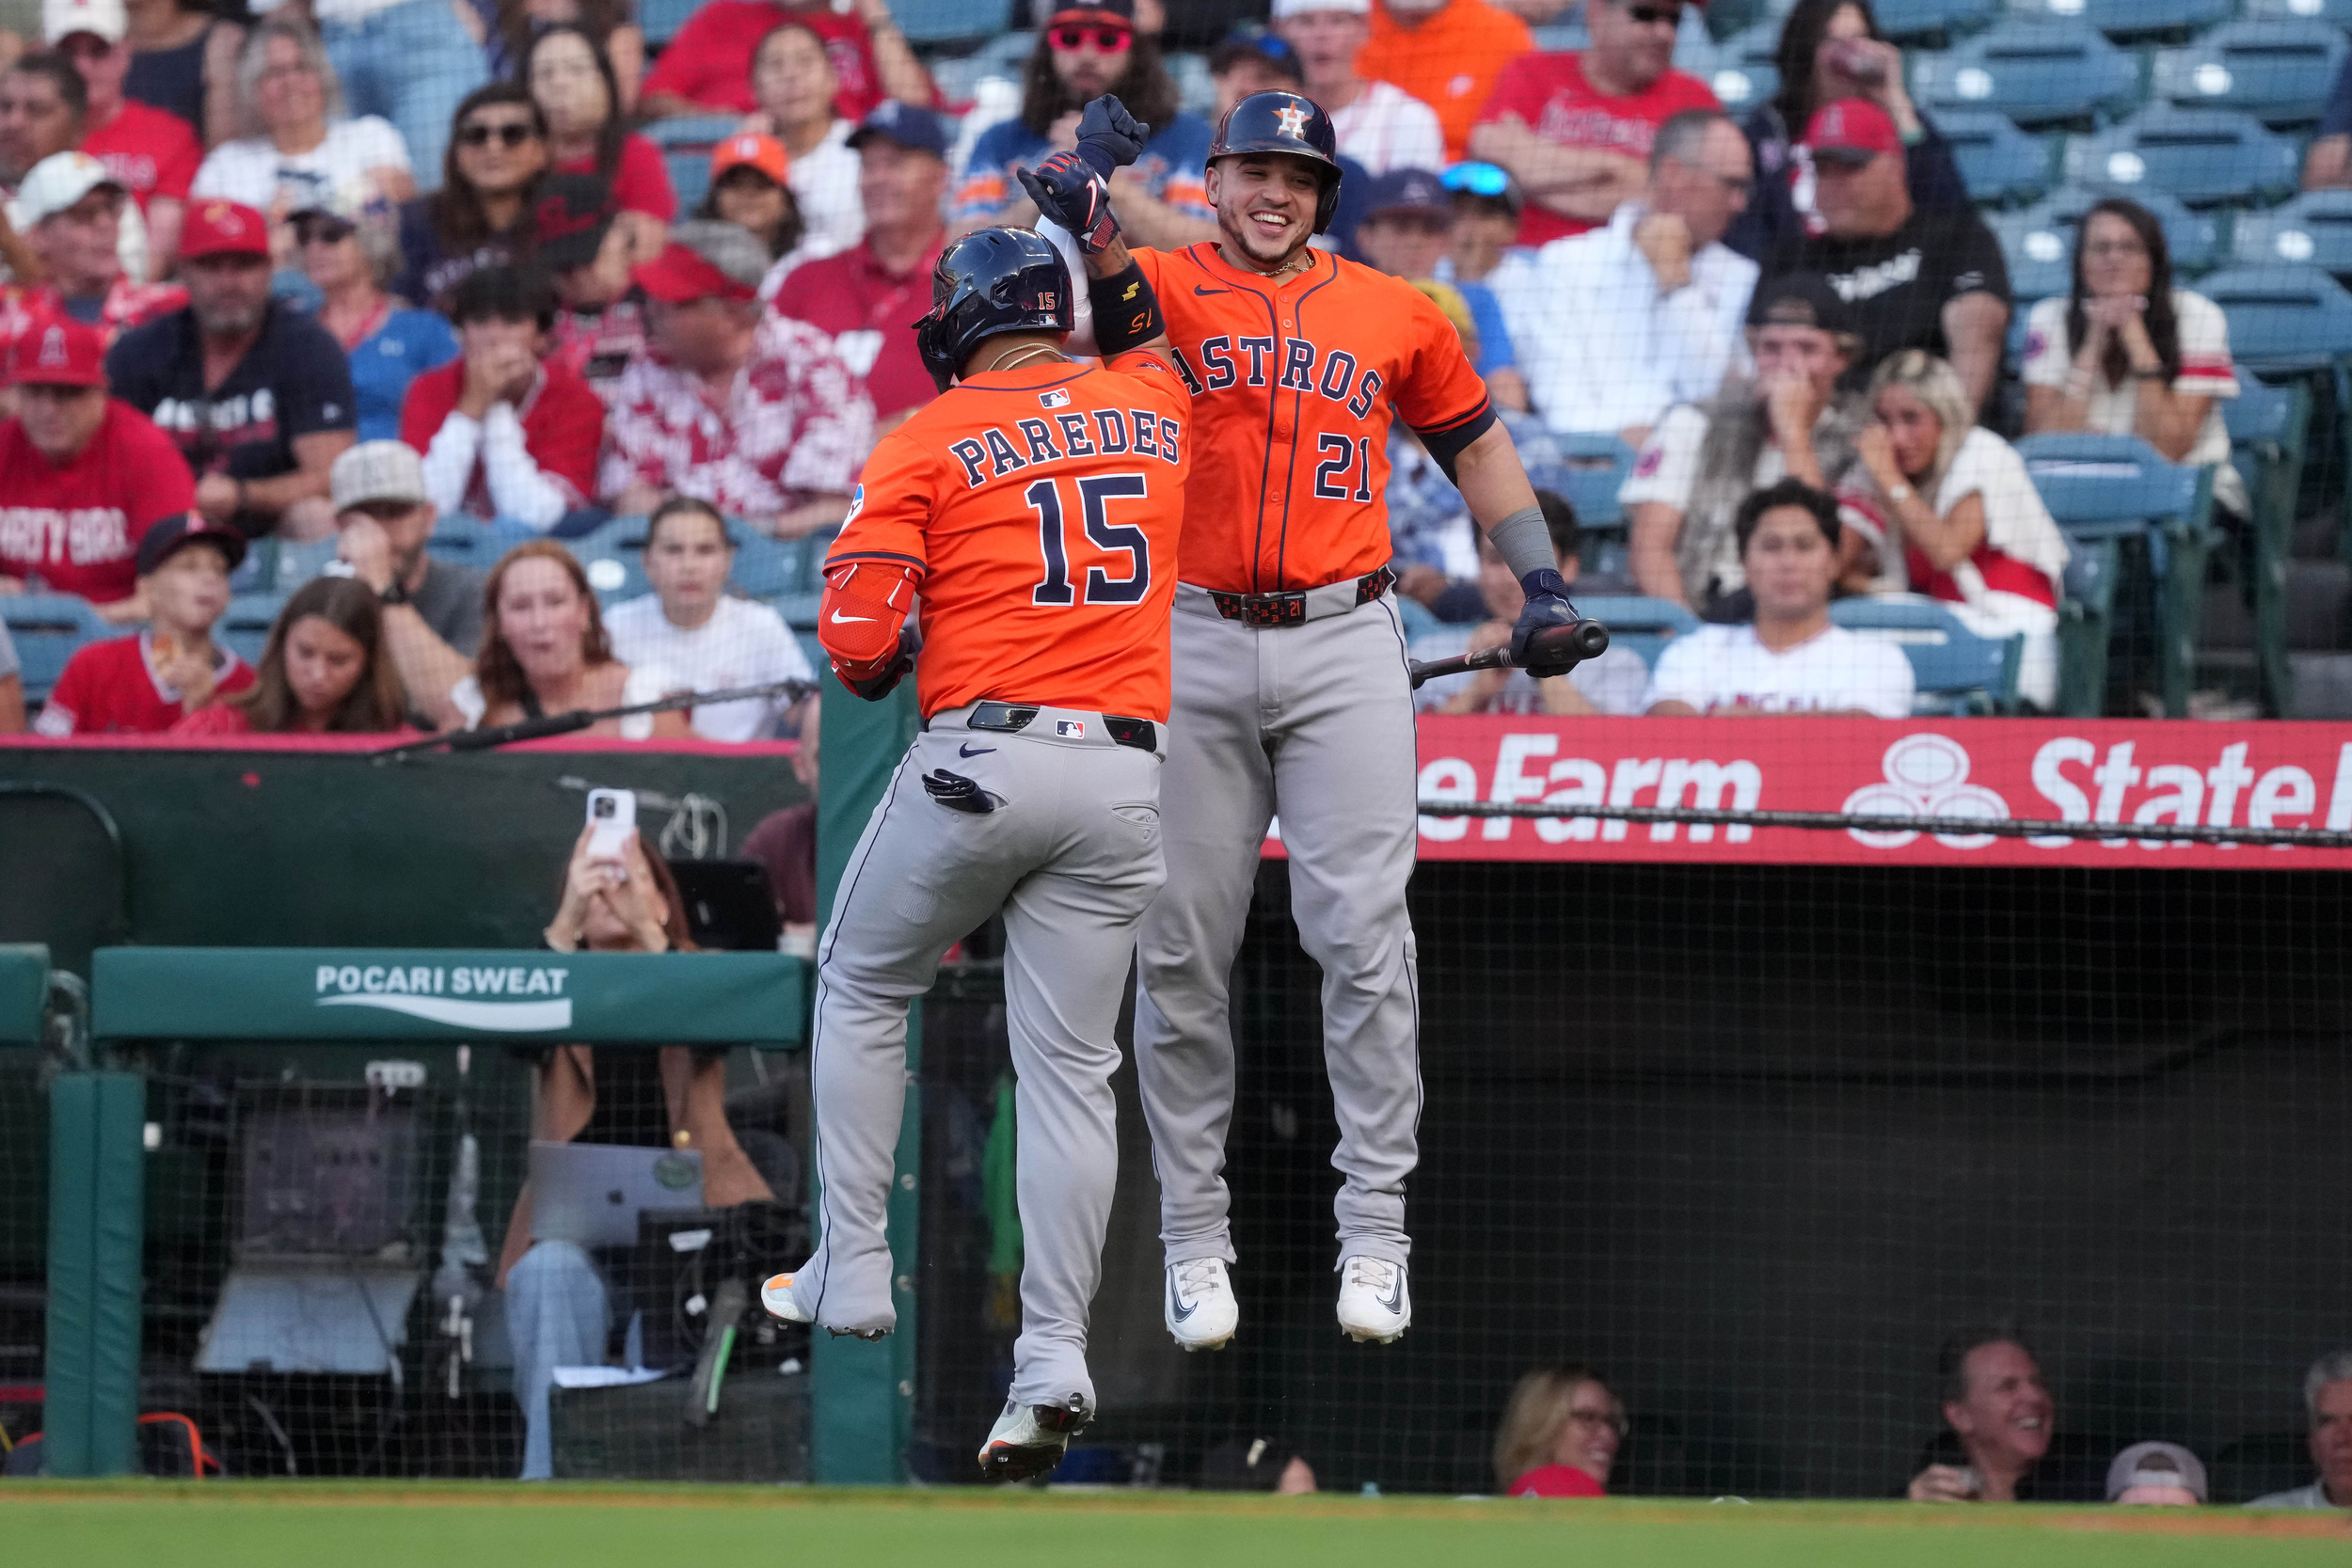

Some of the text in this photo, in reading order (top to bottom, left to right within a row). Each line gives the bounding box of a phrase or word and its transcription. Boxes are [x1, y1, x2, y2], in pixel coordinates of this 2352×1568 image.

[1037, 292, 1056, 310] 15
[1170, 334, 1384, 421] ASTROS
[947, 407, 1180, 490] PAREDES
[1313, 432, 1373, 503] 21
[1024, 472, 1152, 607] 15
[1289, 599, 1301, 617] 21
[1481, 733, 1762, 844] Farm
[2030, 736, 2317, 851] State
[315, 965, 570, 995] POCARI SWEAT
